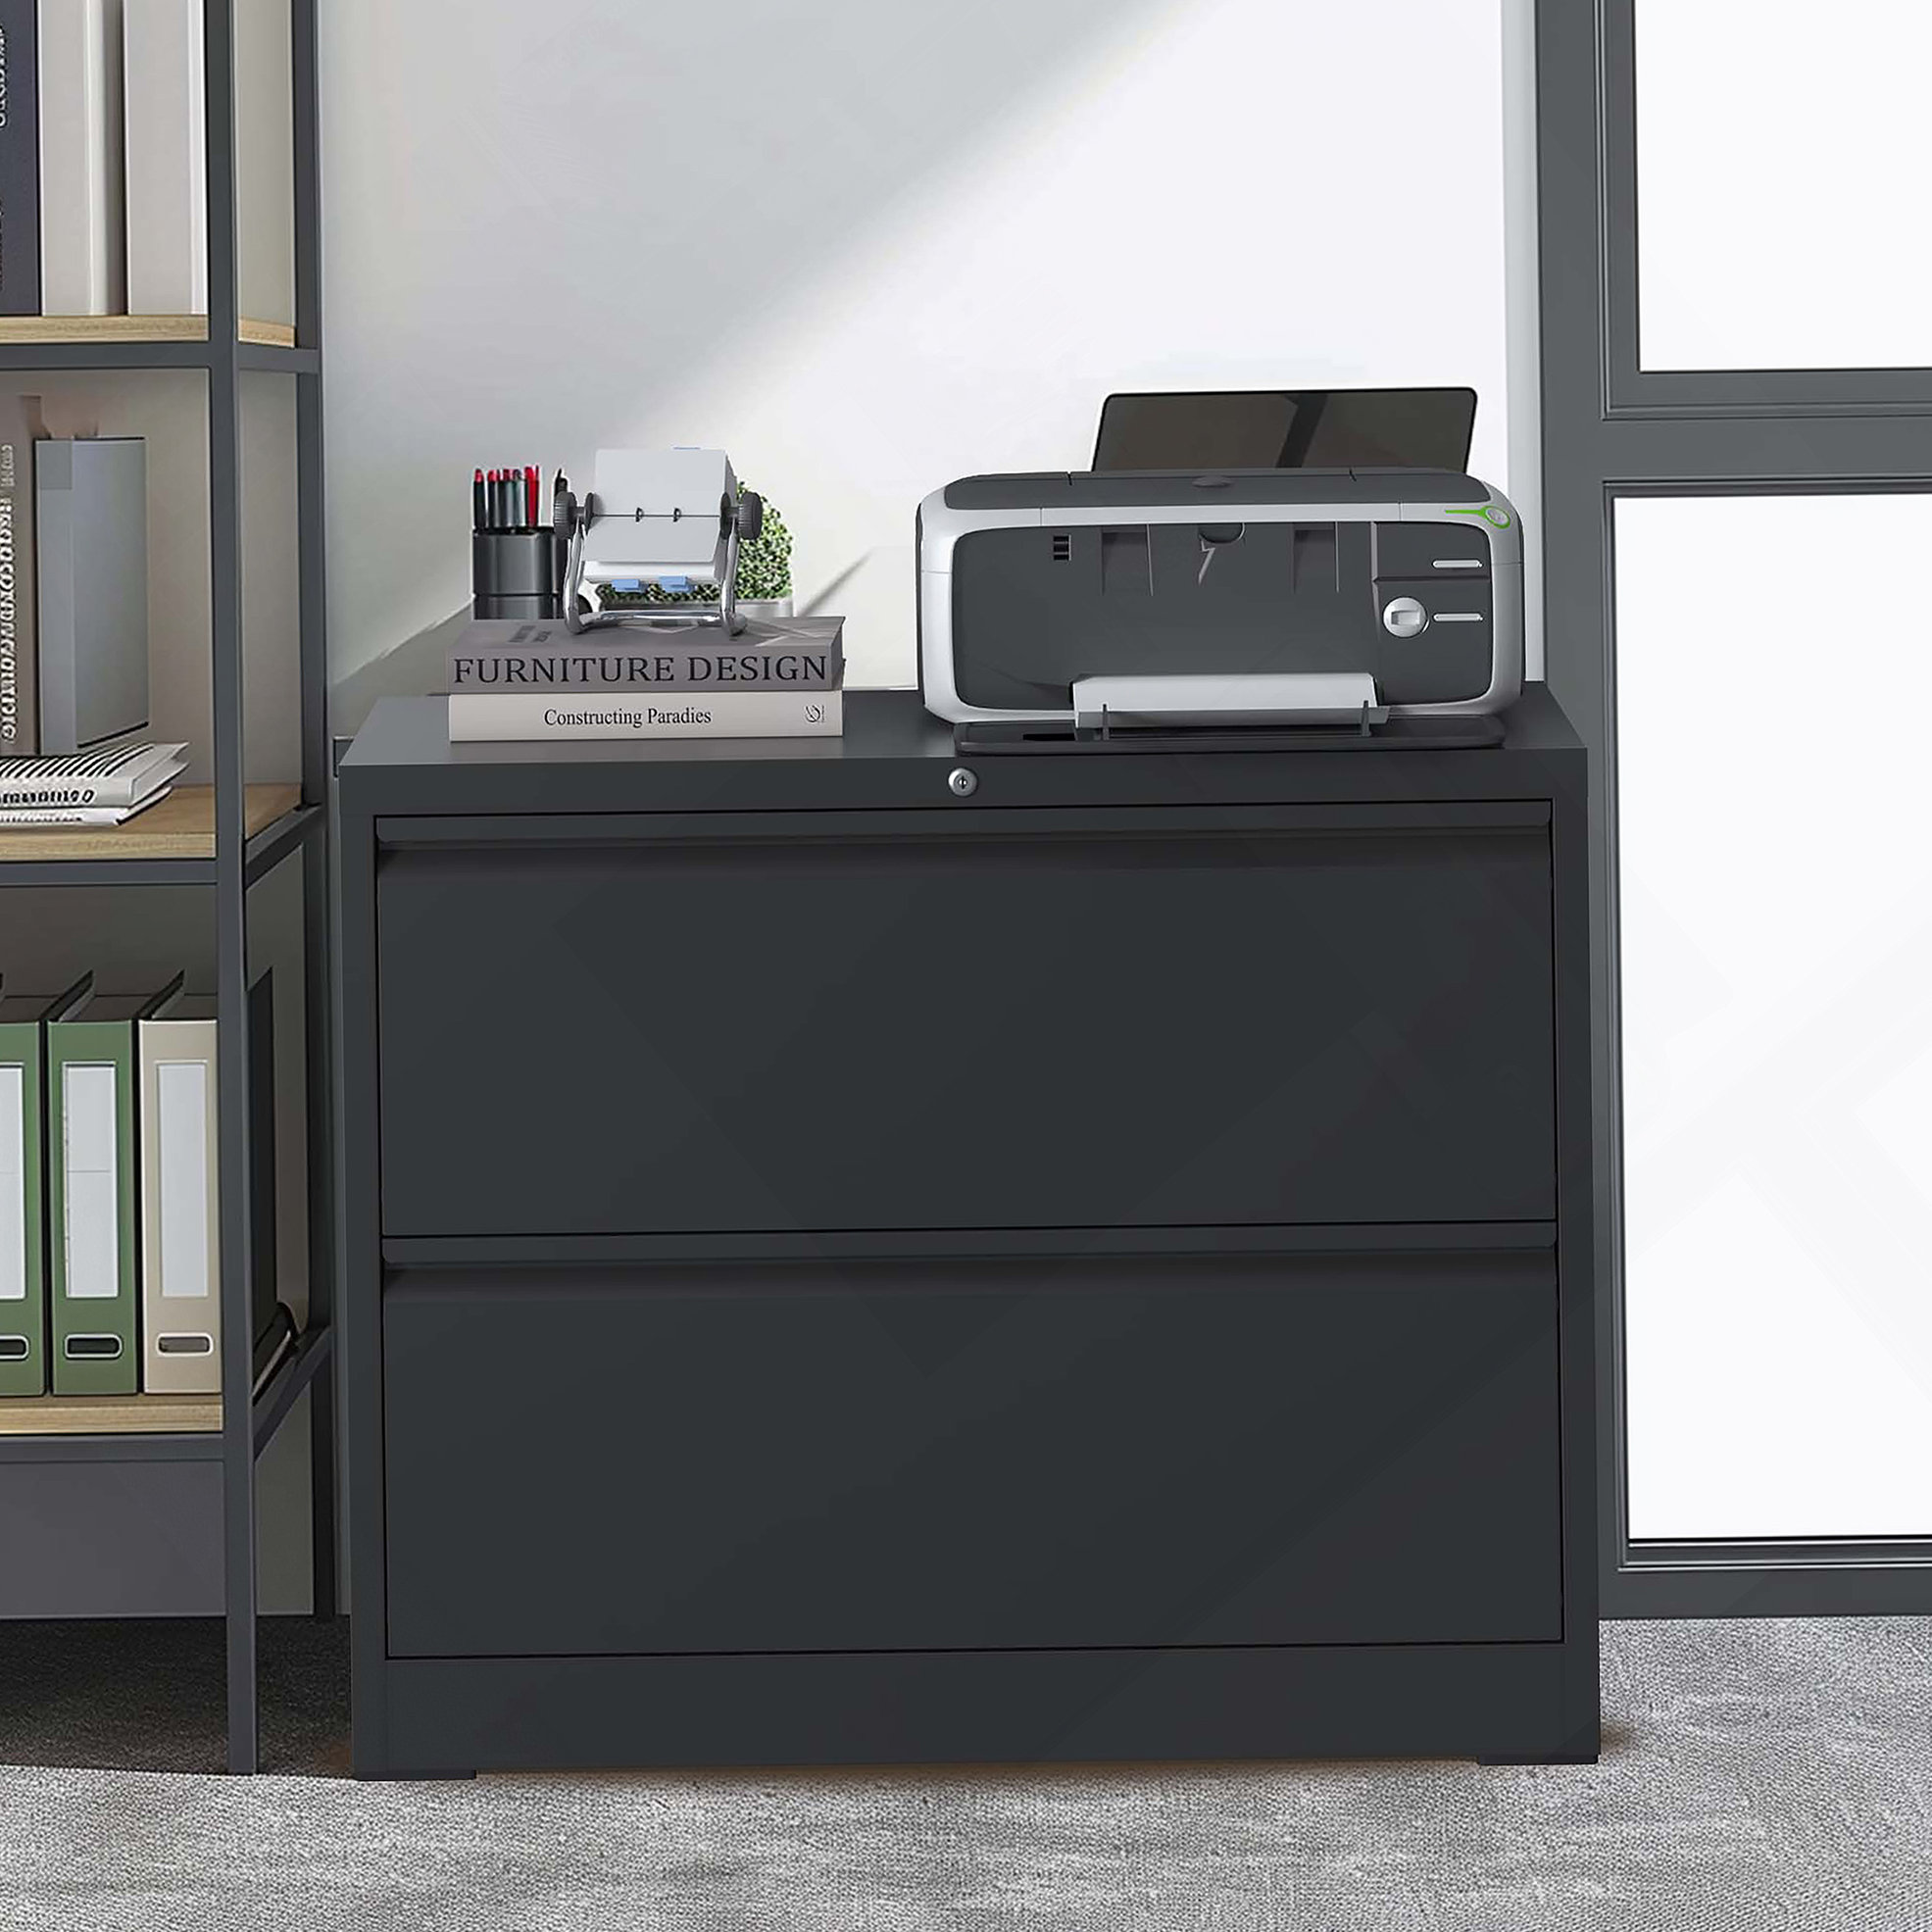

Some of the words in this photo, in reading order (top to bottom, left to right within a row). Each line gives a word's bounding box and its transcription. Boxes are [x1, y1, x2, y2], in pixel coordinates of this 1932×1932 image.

[454, 657, 674, 684] FURNITURE
[687, 655, 827, 682] DESIGN
[544, 708, 643, 728] Constructing
[647, 707, 712, 724] Paradies
